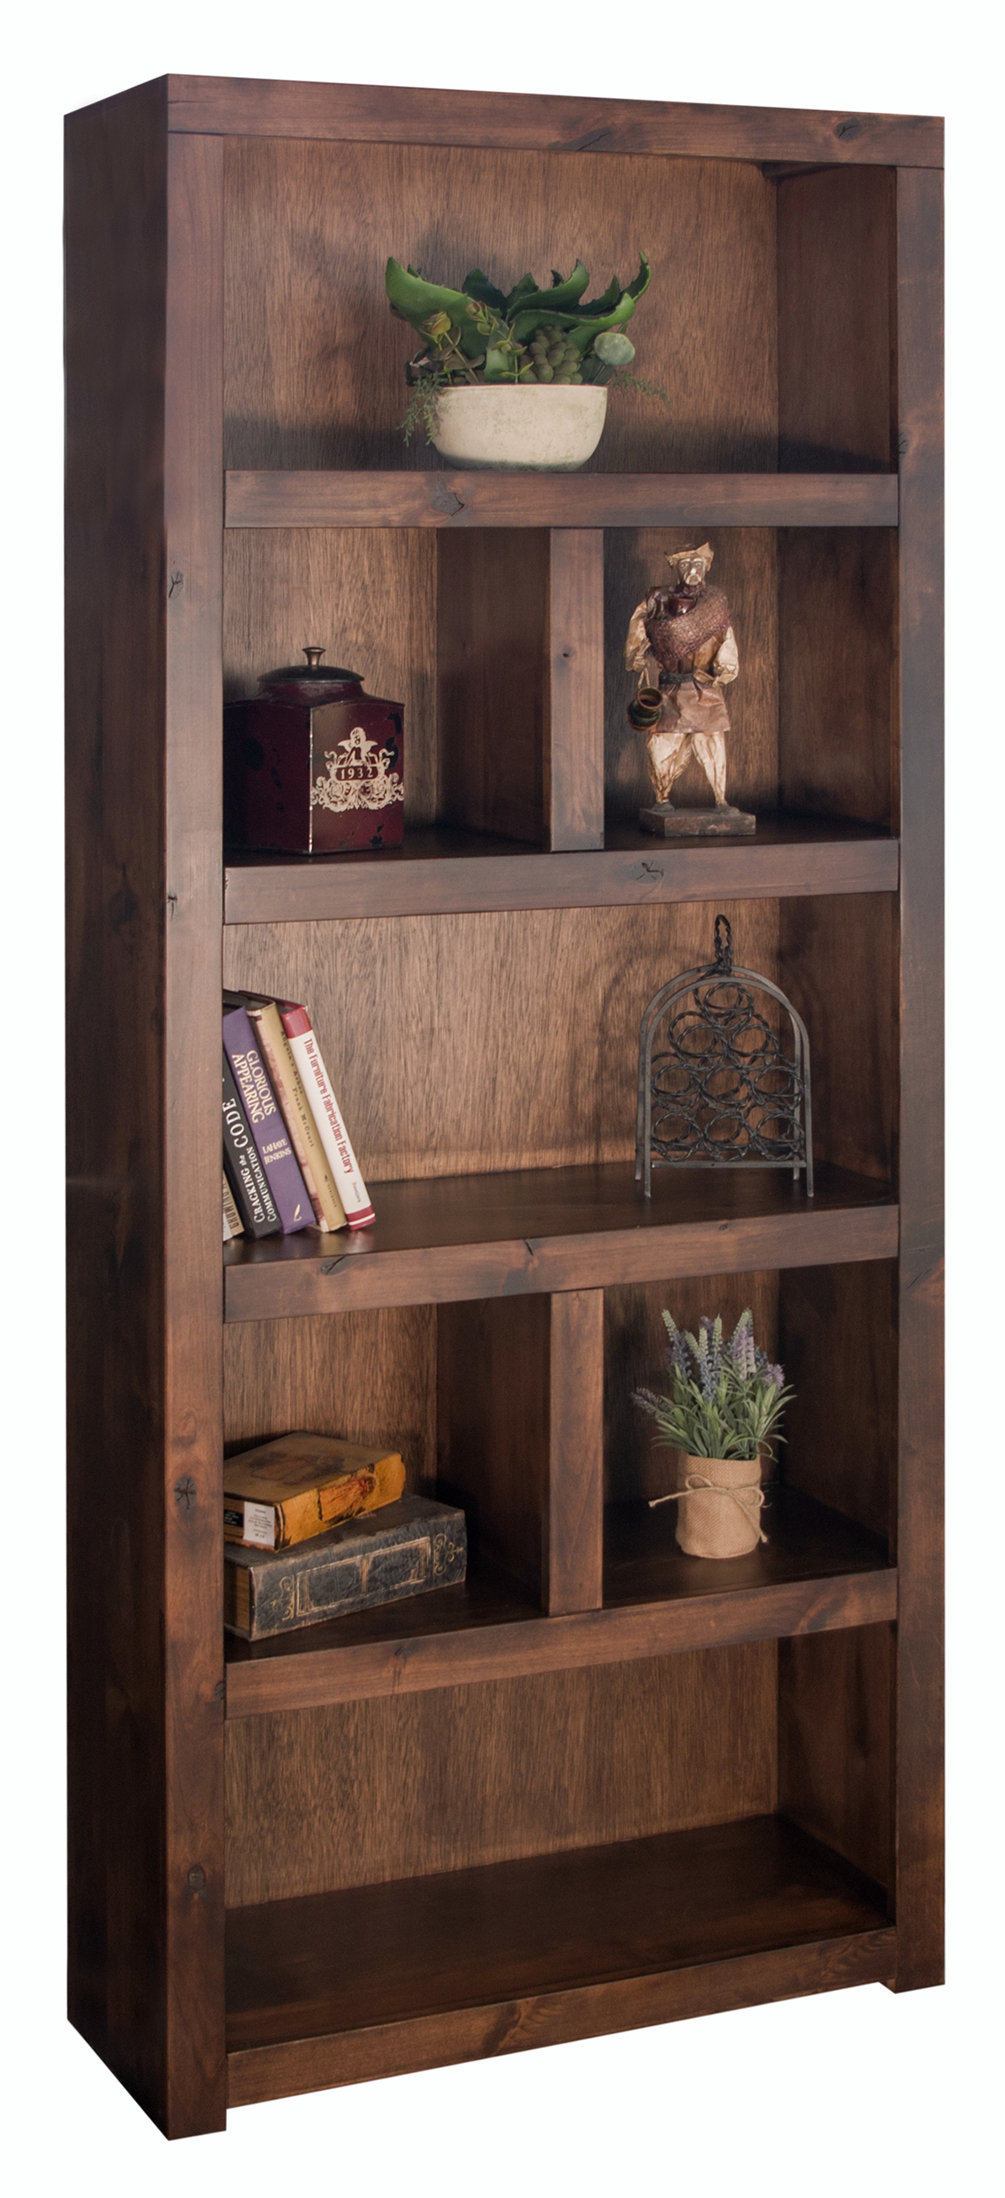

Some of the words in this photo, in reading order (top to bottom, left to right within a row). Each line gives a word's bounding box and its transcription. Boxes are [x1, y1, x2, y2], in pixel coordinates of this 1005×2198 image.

[341, 767, 374, 780] 1932
[231, 1054, 266, 1124] APPEARING
[246, 1050, 277, 1116] GLORIOUS
[303, 1038, 315, 1055] The
[309, 1054, 328, 1095] Furniture
[322, 1094, 343, 1141] Fabrication
[337, 1140, 355, 1174] Factory
[222, 1098, 249, 1148] CODE
[239, 1154, 247, 1167] the
[246, 1146, 277, 1222] COMMUNICATION
[263, 1147, 292, 1165] JENKINS
[240, 1167, 266, 1223] CRACKING
